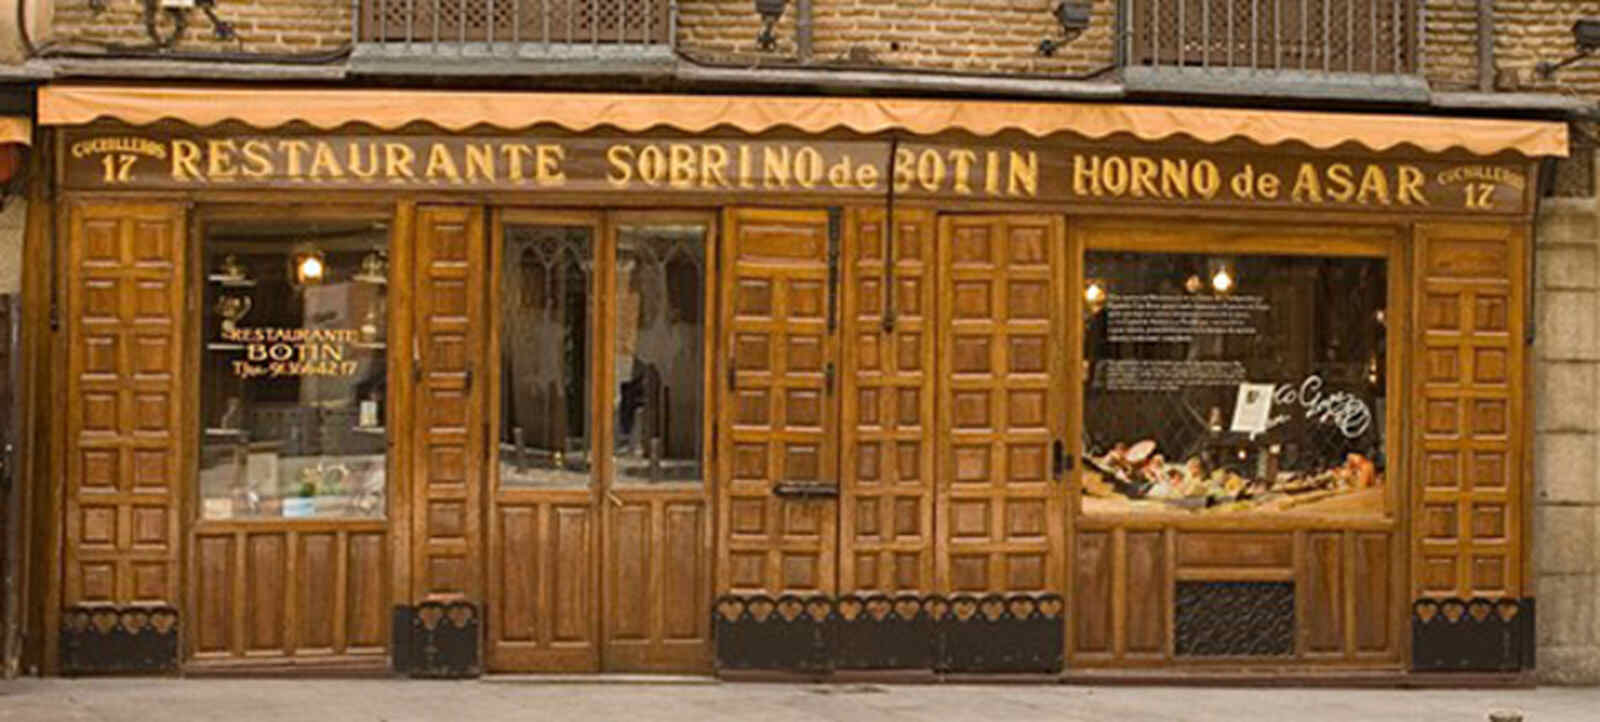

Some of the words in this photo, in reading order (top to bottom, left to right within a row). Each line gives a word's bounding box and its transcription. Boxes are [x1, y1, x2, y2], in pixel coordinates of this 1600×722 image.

[102, 153, 138, 182] 17
[171, 138, 567, 187] RESTAURANTE
[606, 143, 824, 190] SOBRINO
[829, 150, 879, 189] de
[894, 148, 1039, 196] BOTIN
[1073, 154, 1221, 199] HORNO
[1231, 164, 1281, 199] de
[1291, 162, 1430, 206] ASAR
[1464, 182, 1496, 208] 17
[247, 343, 343, 361] BOTIN
